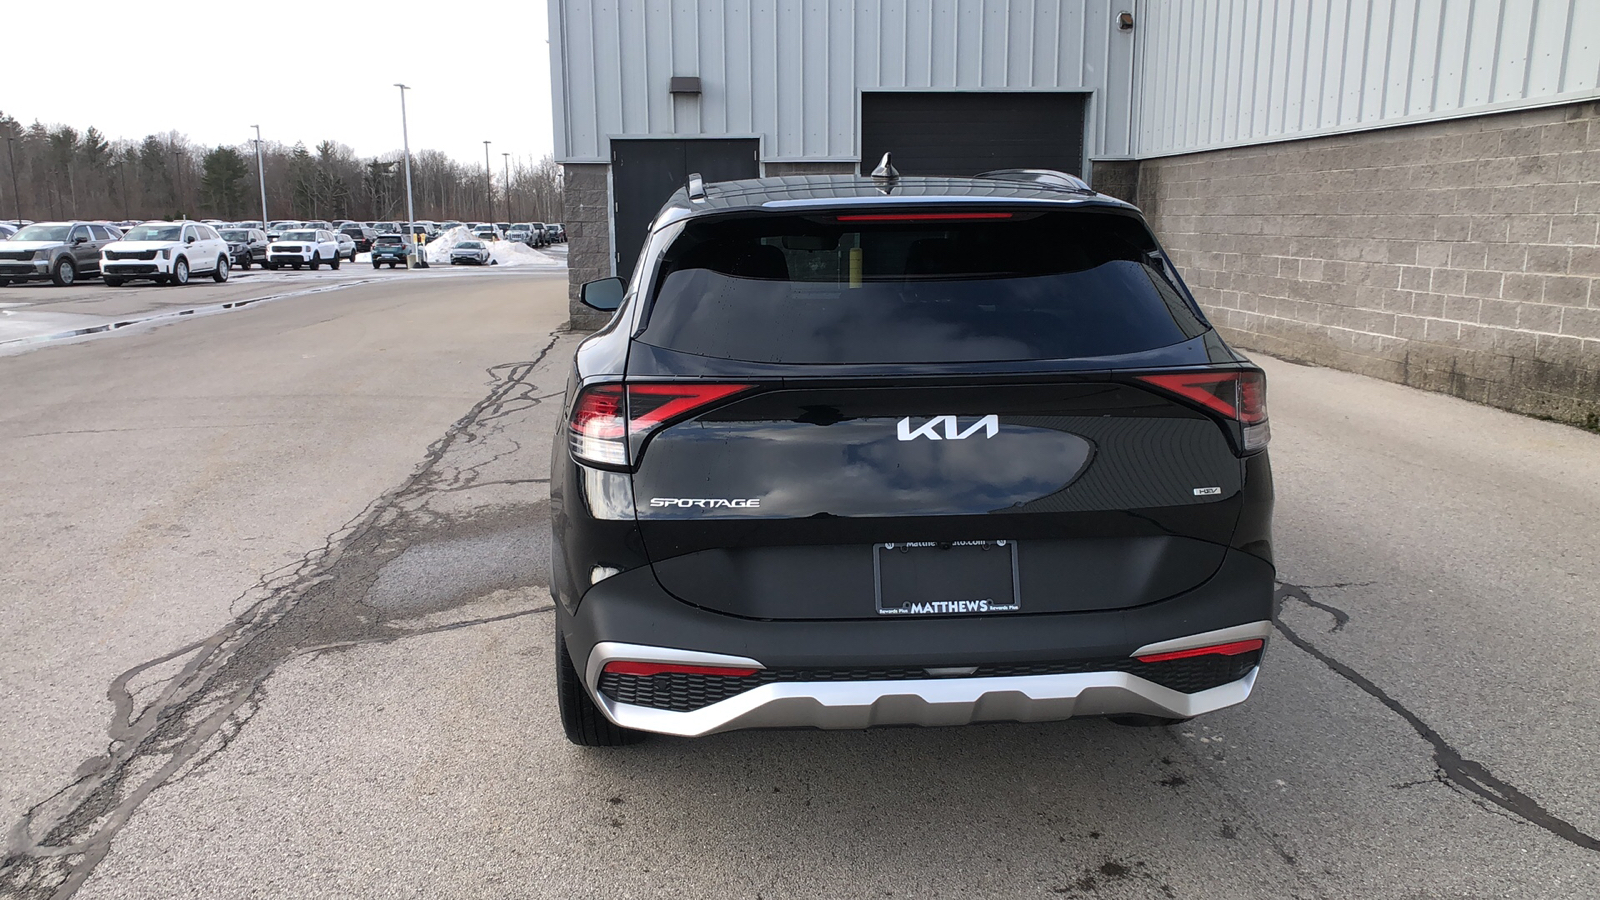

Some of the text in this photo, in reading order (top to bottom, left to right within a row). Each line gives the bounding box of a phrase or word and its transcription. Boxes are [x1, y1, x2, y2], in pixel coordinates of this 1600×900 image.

[897, 414, 999, 441] KIA
[650, 497, 760, 508] SPORTAGE
[911, 600, 988, 614] MATTHEWS
